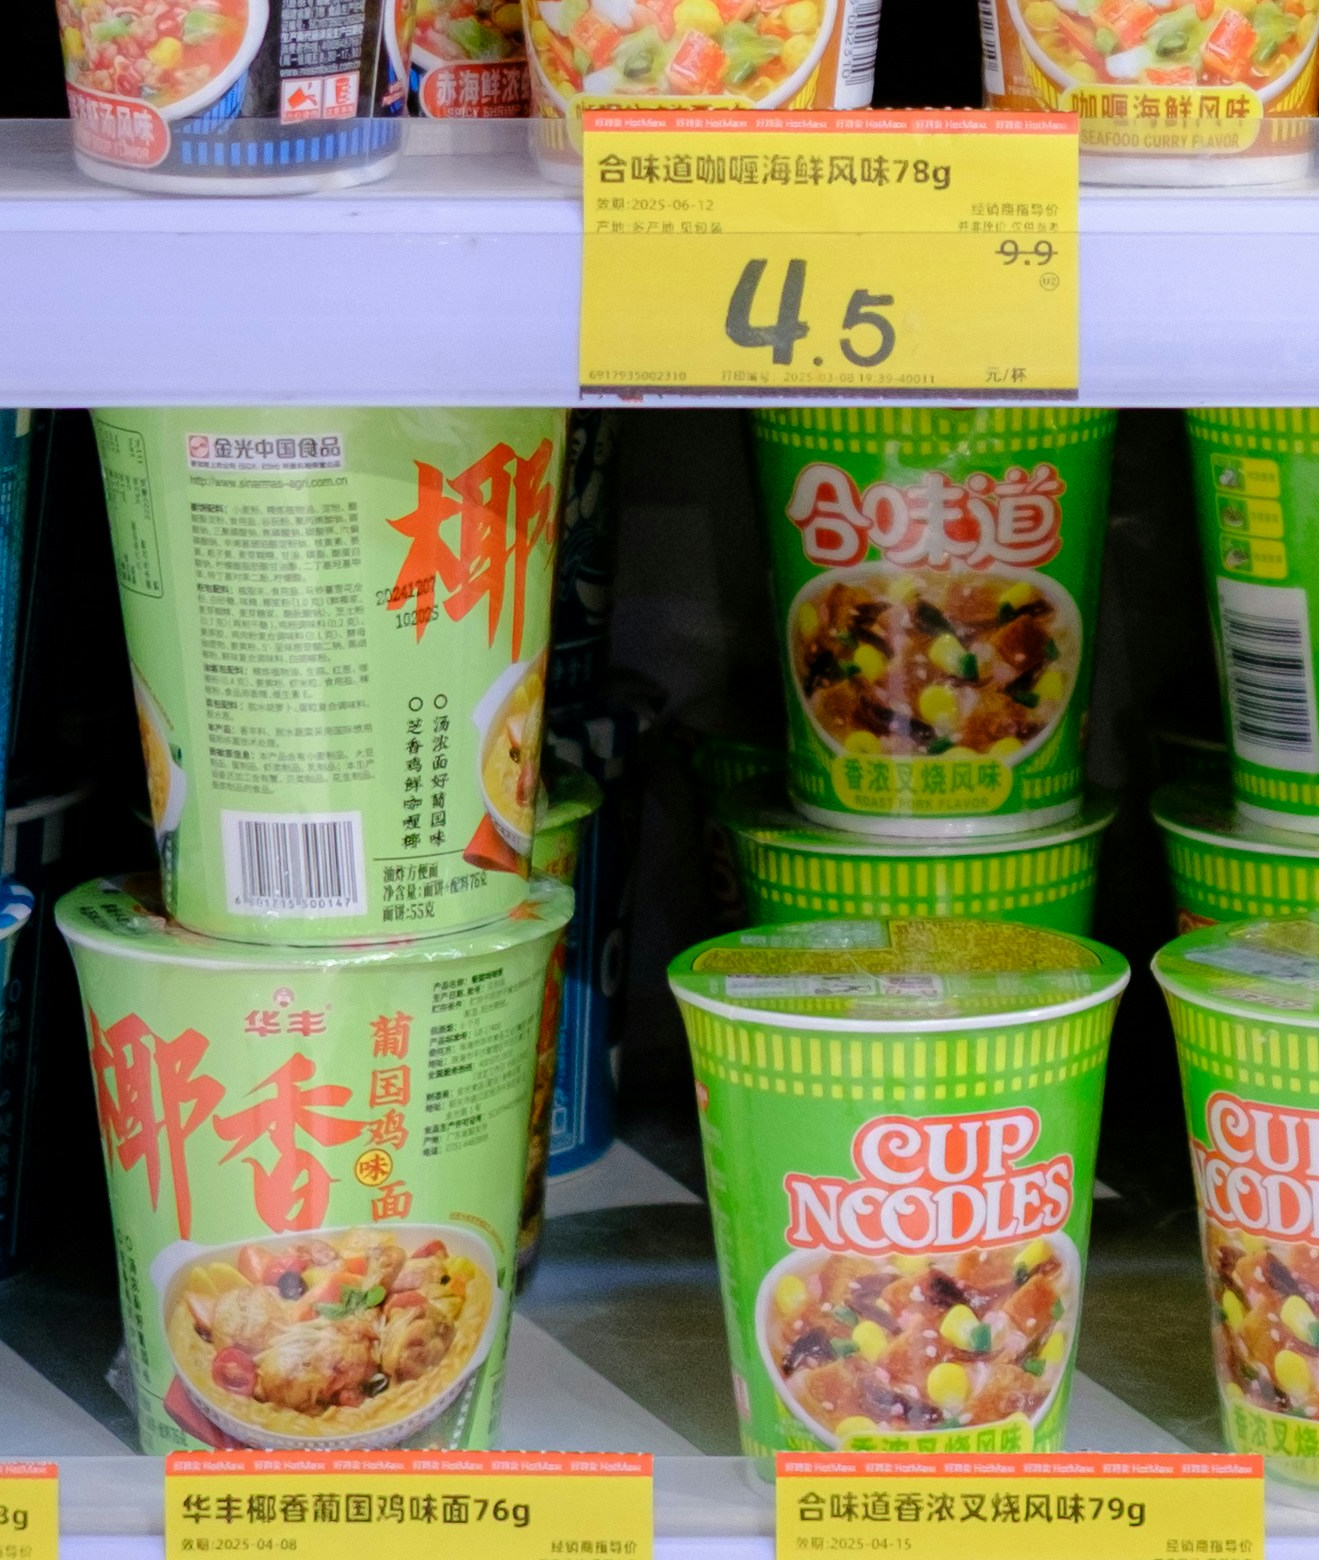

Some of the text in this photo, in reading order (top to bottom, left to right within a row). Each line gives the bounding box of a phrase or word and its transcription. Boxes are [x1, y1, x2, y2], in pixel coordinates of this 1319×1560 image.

[598, 154, 952, 189] 合味道咖喱海鲜风味78g
[596, 197, 714, 212] 效期:2025-06-12
[995, 239, 1059, 267] 9.9
[725, 258, 896, 368] 4.5
[214, 436, 341, 458] 金光中国食品
[354, 1011, 414, 1222] 葡国鸡味面
[852, 1110, 1040, 1185] CUP
[785, 1168, 1072, 1252] NOODLES
[182, 1493, 532, 1527] 华丰椰香葡国鸡味面76g
[797, 1491, 1147, 1526] 合味道香浓叉烧风味79g
[796, 1536, 913, 1552] 效期:2025-04-15
